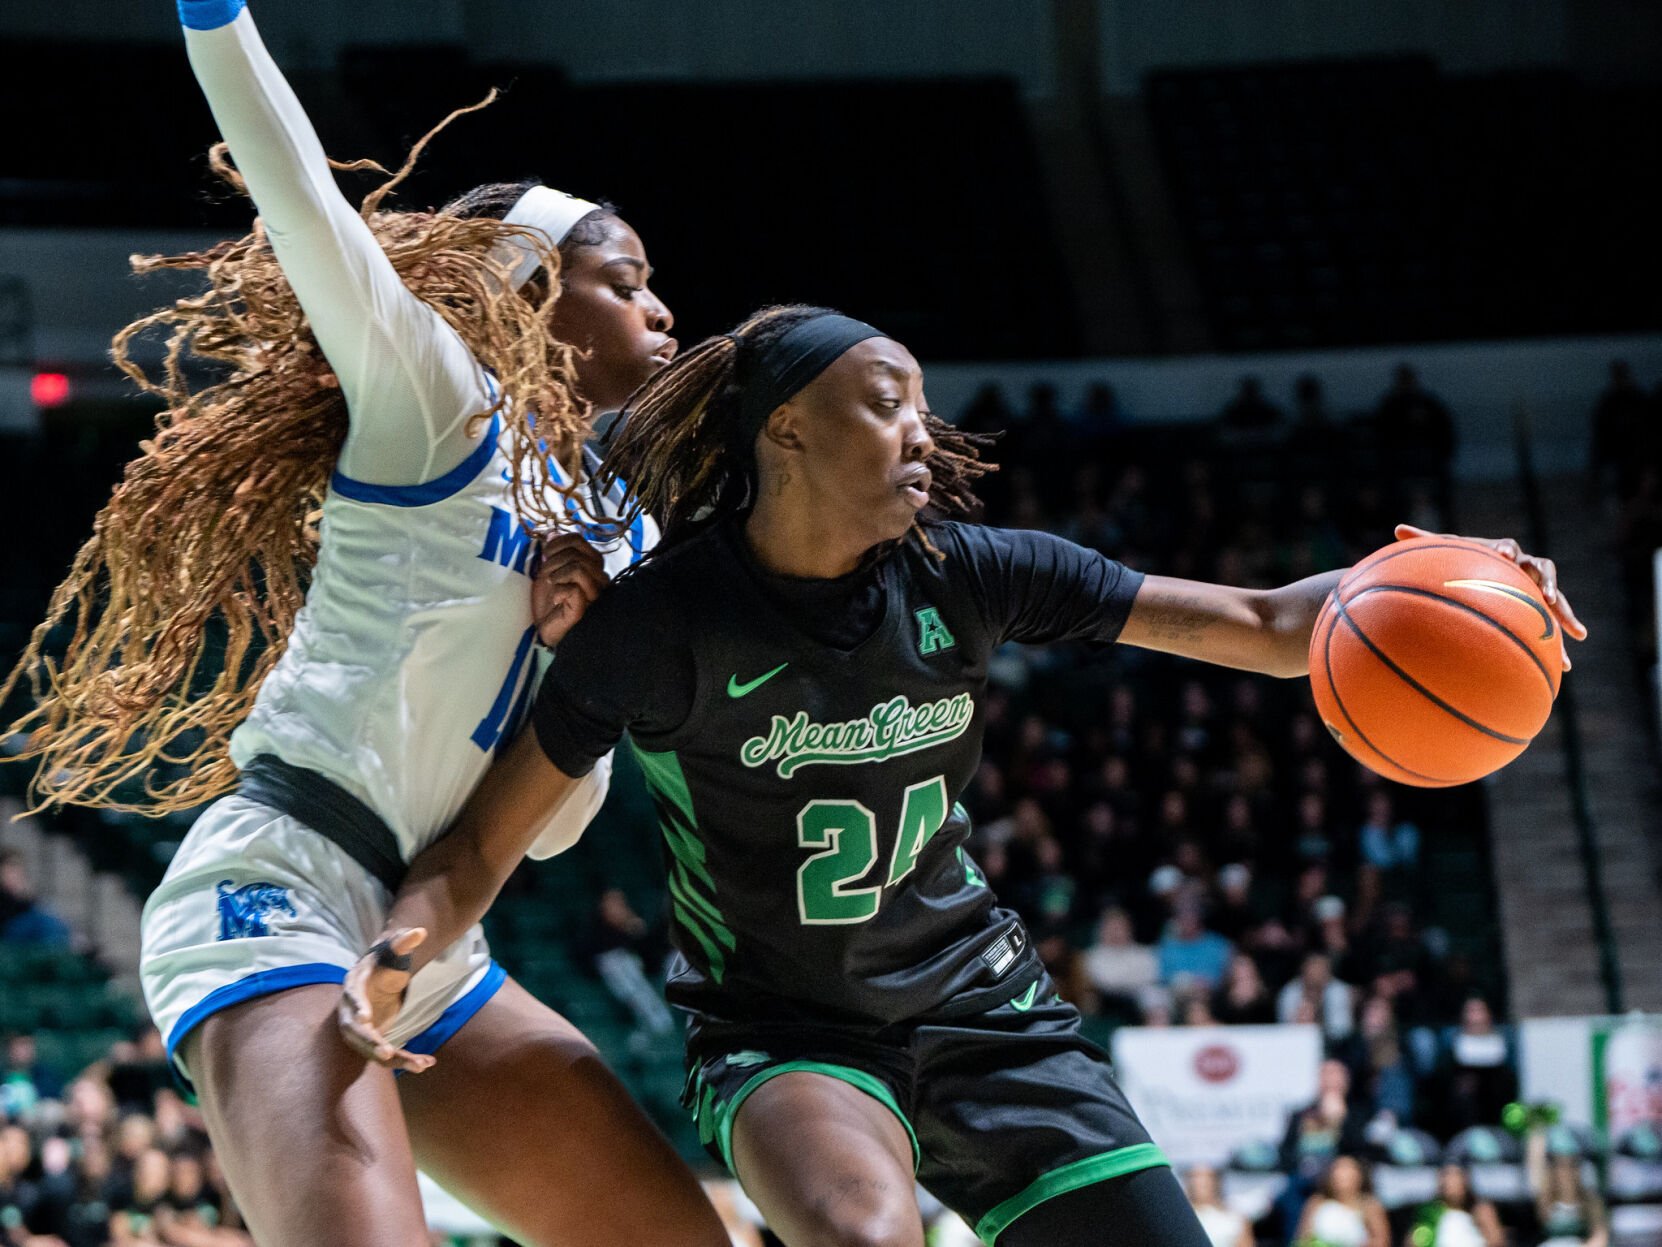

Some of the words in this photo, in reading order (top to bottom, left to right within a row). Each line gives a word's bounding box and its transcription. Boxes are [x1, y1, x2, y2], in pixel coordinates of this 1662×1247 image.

[914, 606, 957, 656] A
[740, 711, 873, 768] Mean
[869, 694, 975, 762] Green
[796, 774, 949, 926] 24
